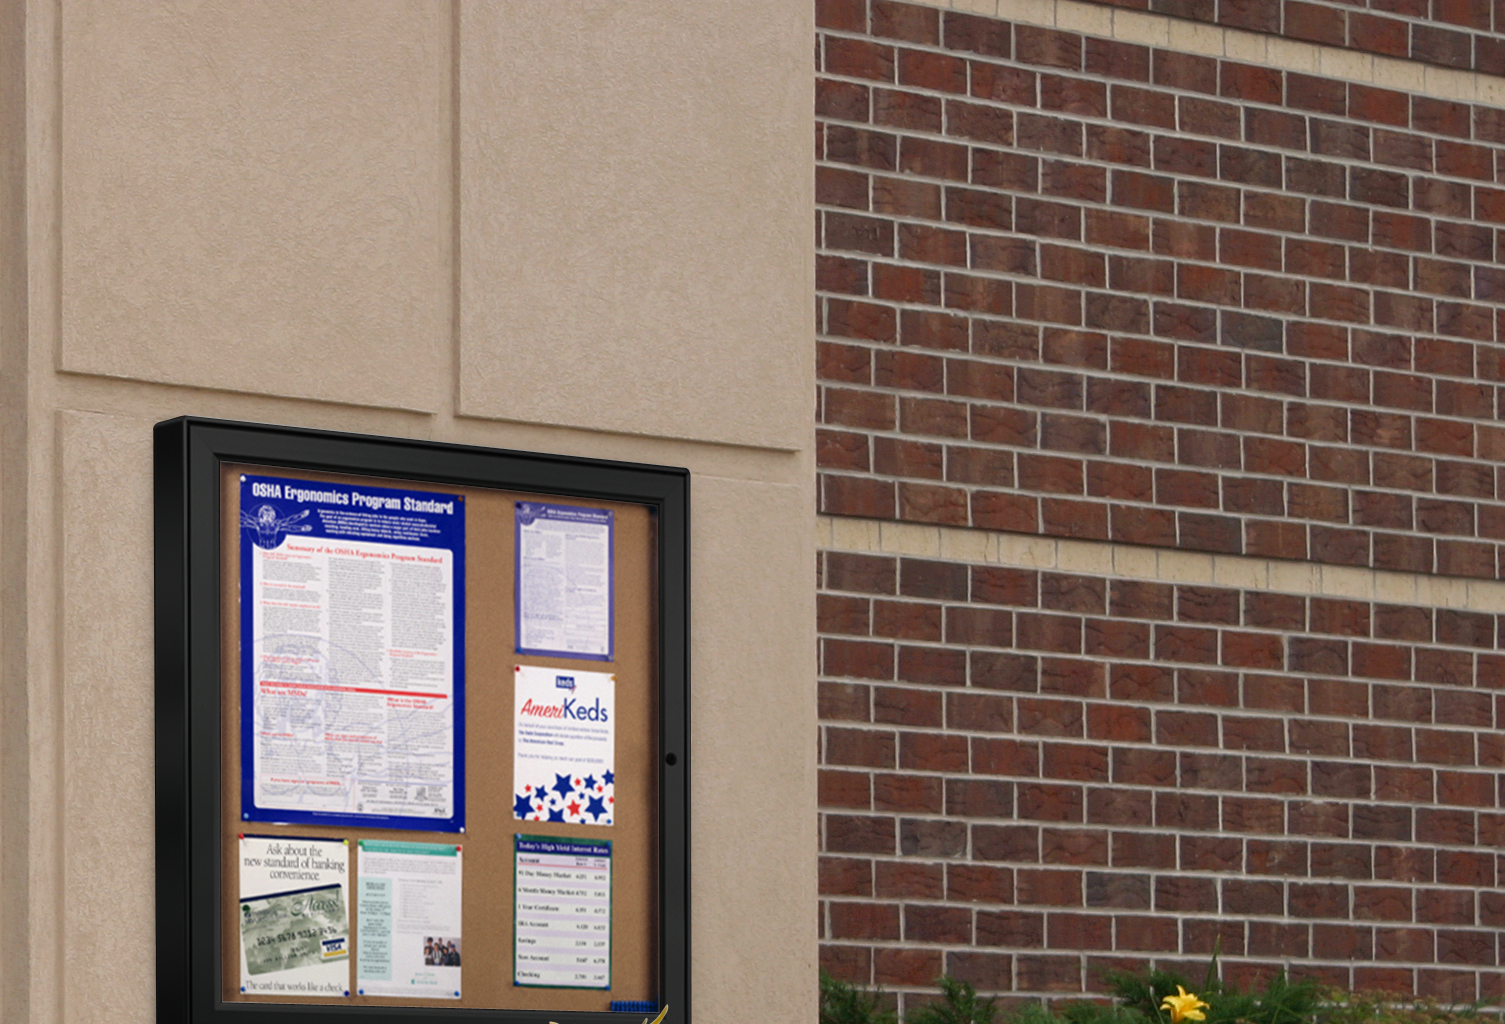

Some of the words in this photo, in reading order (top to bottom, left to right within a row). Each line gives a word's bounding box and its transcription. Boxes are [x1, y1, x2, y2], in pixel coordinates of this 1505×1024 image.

[252, 482, 282, 499] OSHA
[284, 485, 349, 506] Ergonomics
[352, 492, 401, 510] Program
[403, 497, 454, 515] Standard
[521, 697, 608, 722] AmeriKeds
[266, 844, 283, 856] Ask
[284, 844, 307, 857] about
[309, 845, 322, 857] the
[244, 858, 262, 866] new
[264, 857, 300, 868] standard
[301, 857, 311, 868] of
[312, 858, 346, 874] banking
[326, 944, 342, 952] VISA
[245, 980, 256, 990] The
[257, 981, 273, 991] card
[274, 981, 287, 991] that
[288, 982, 307, 992] works
[308, 982, 318, 992] like
